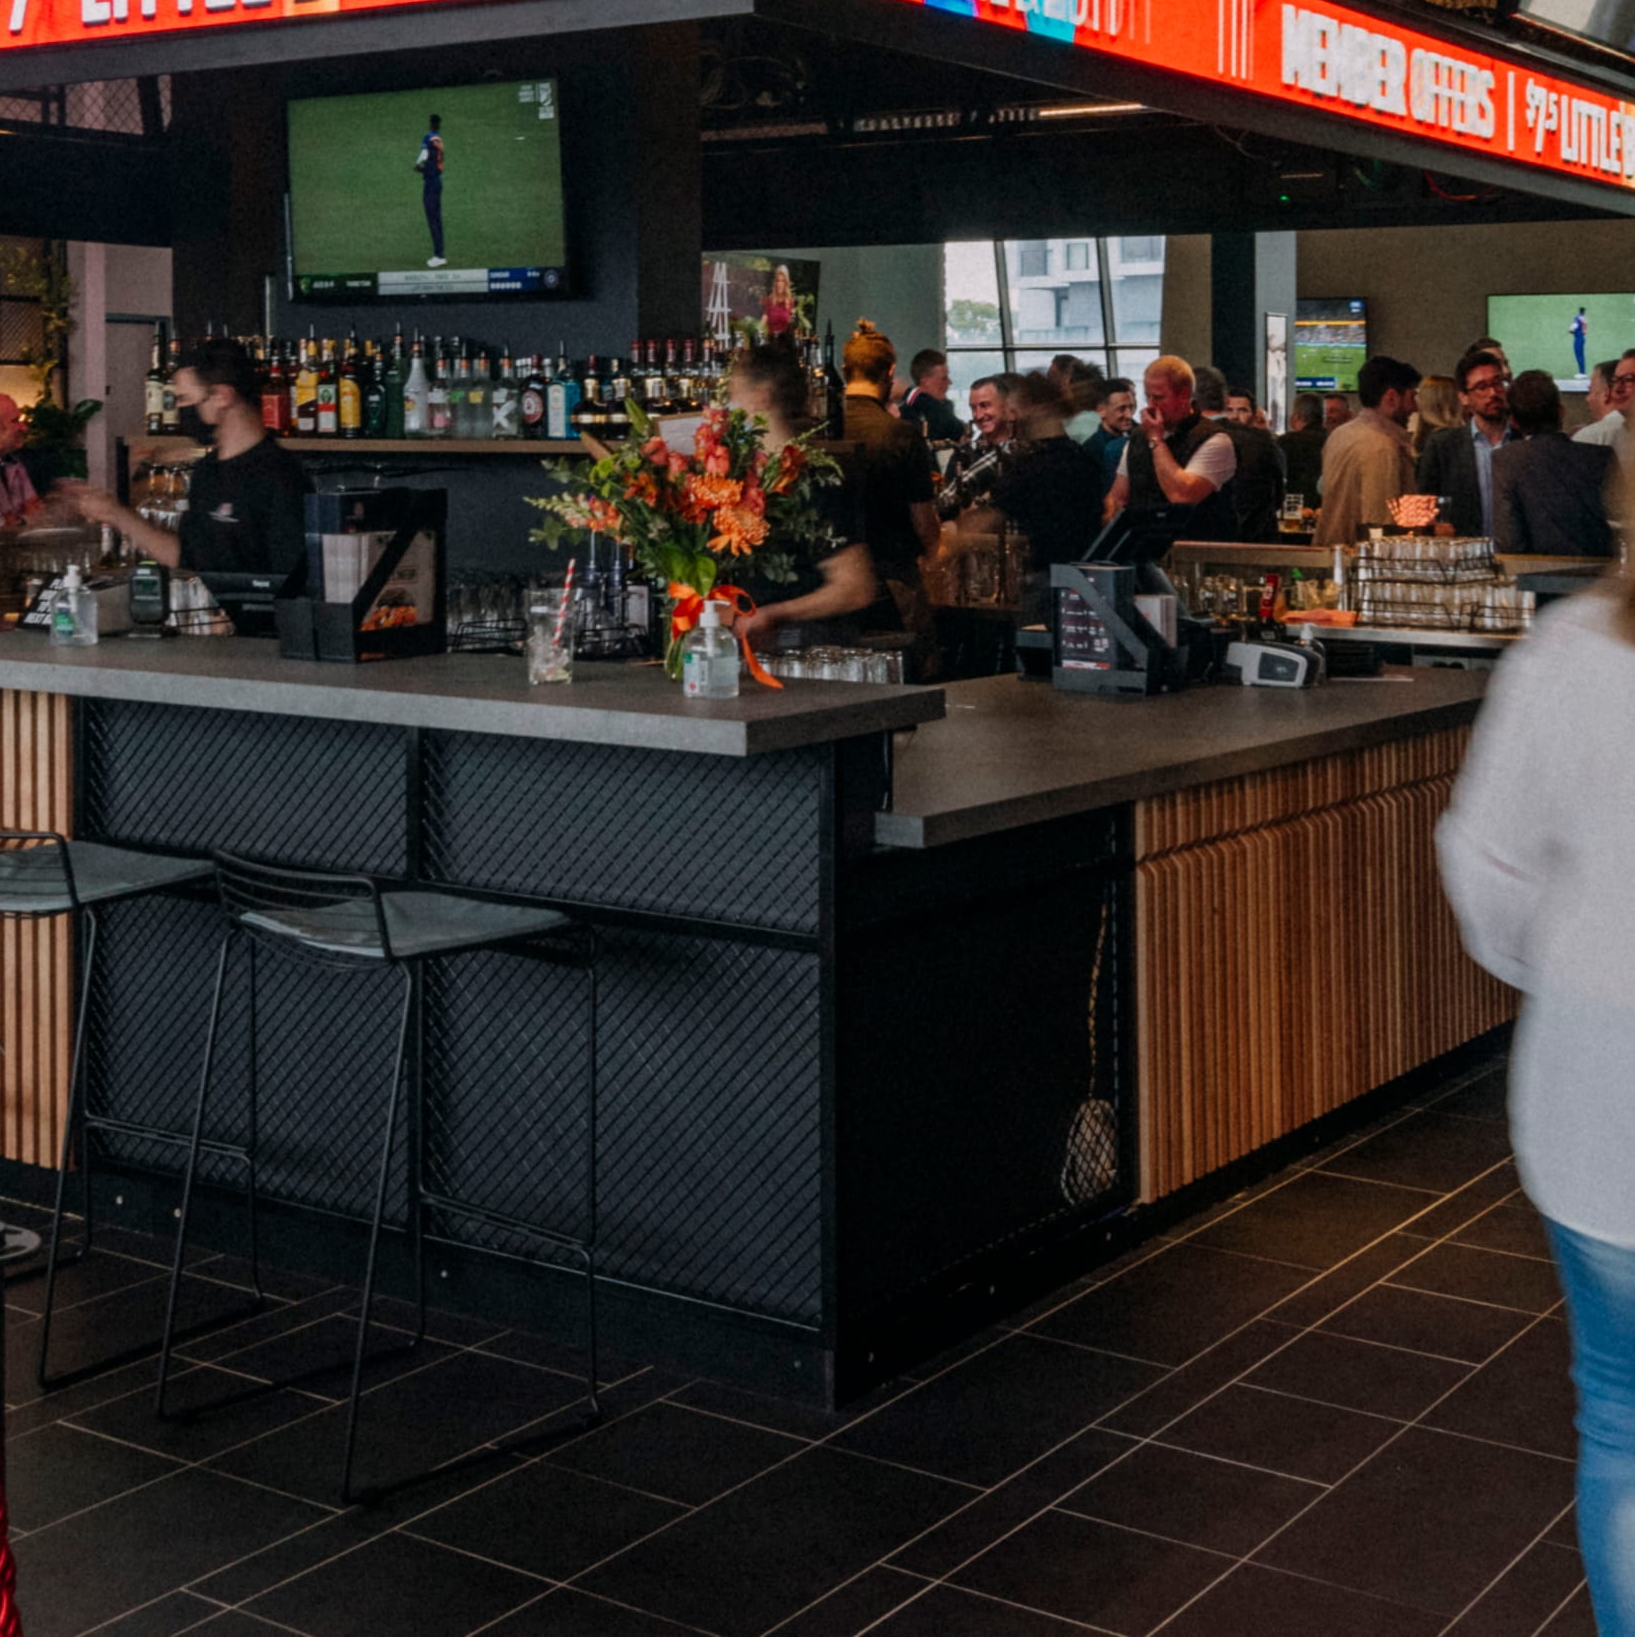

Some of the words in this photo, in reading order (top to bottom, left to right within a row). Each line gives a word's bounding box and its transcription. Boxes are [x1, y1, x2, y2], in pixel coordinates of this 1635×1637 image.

[1281, 3, 1406, 116] MEMBER
[1410, 48, 1496, 140] OFFERS
[1525, 77, 1558, 153] $7.5
[1560, 94, 1621, 174] LITTLE
